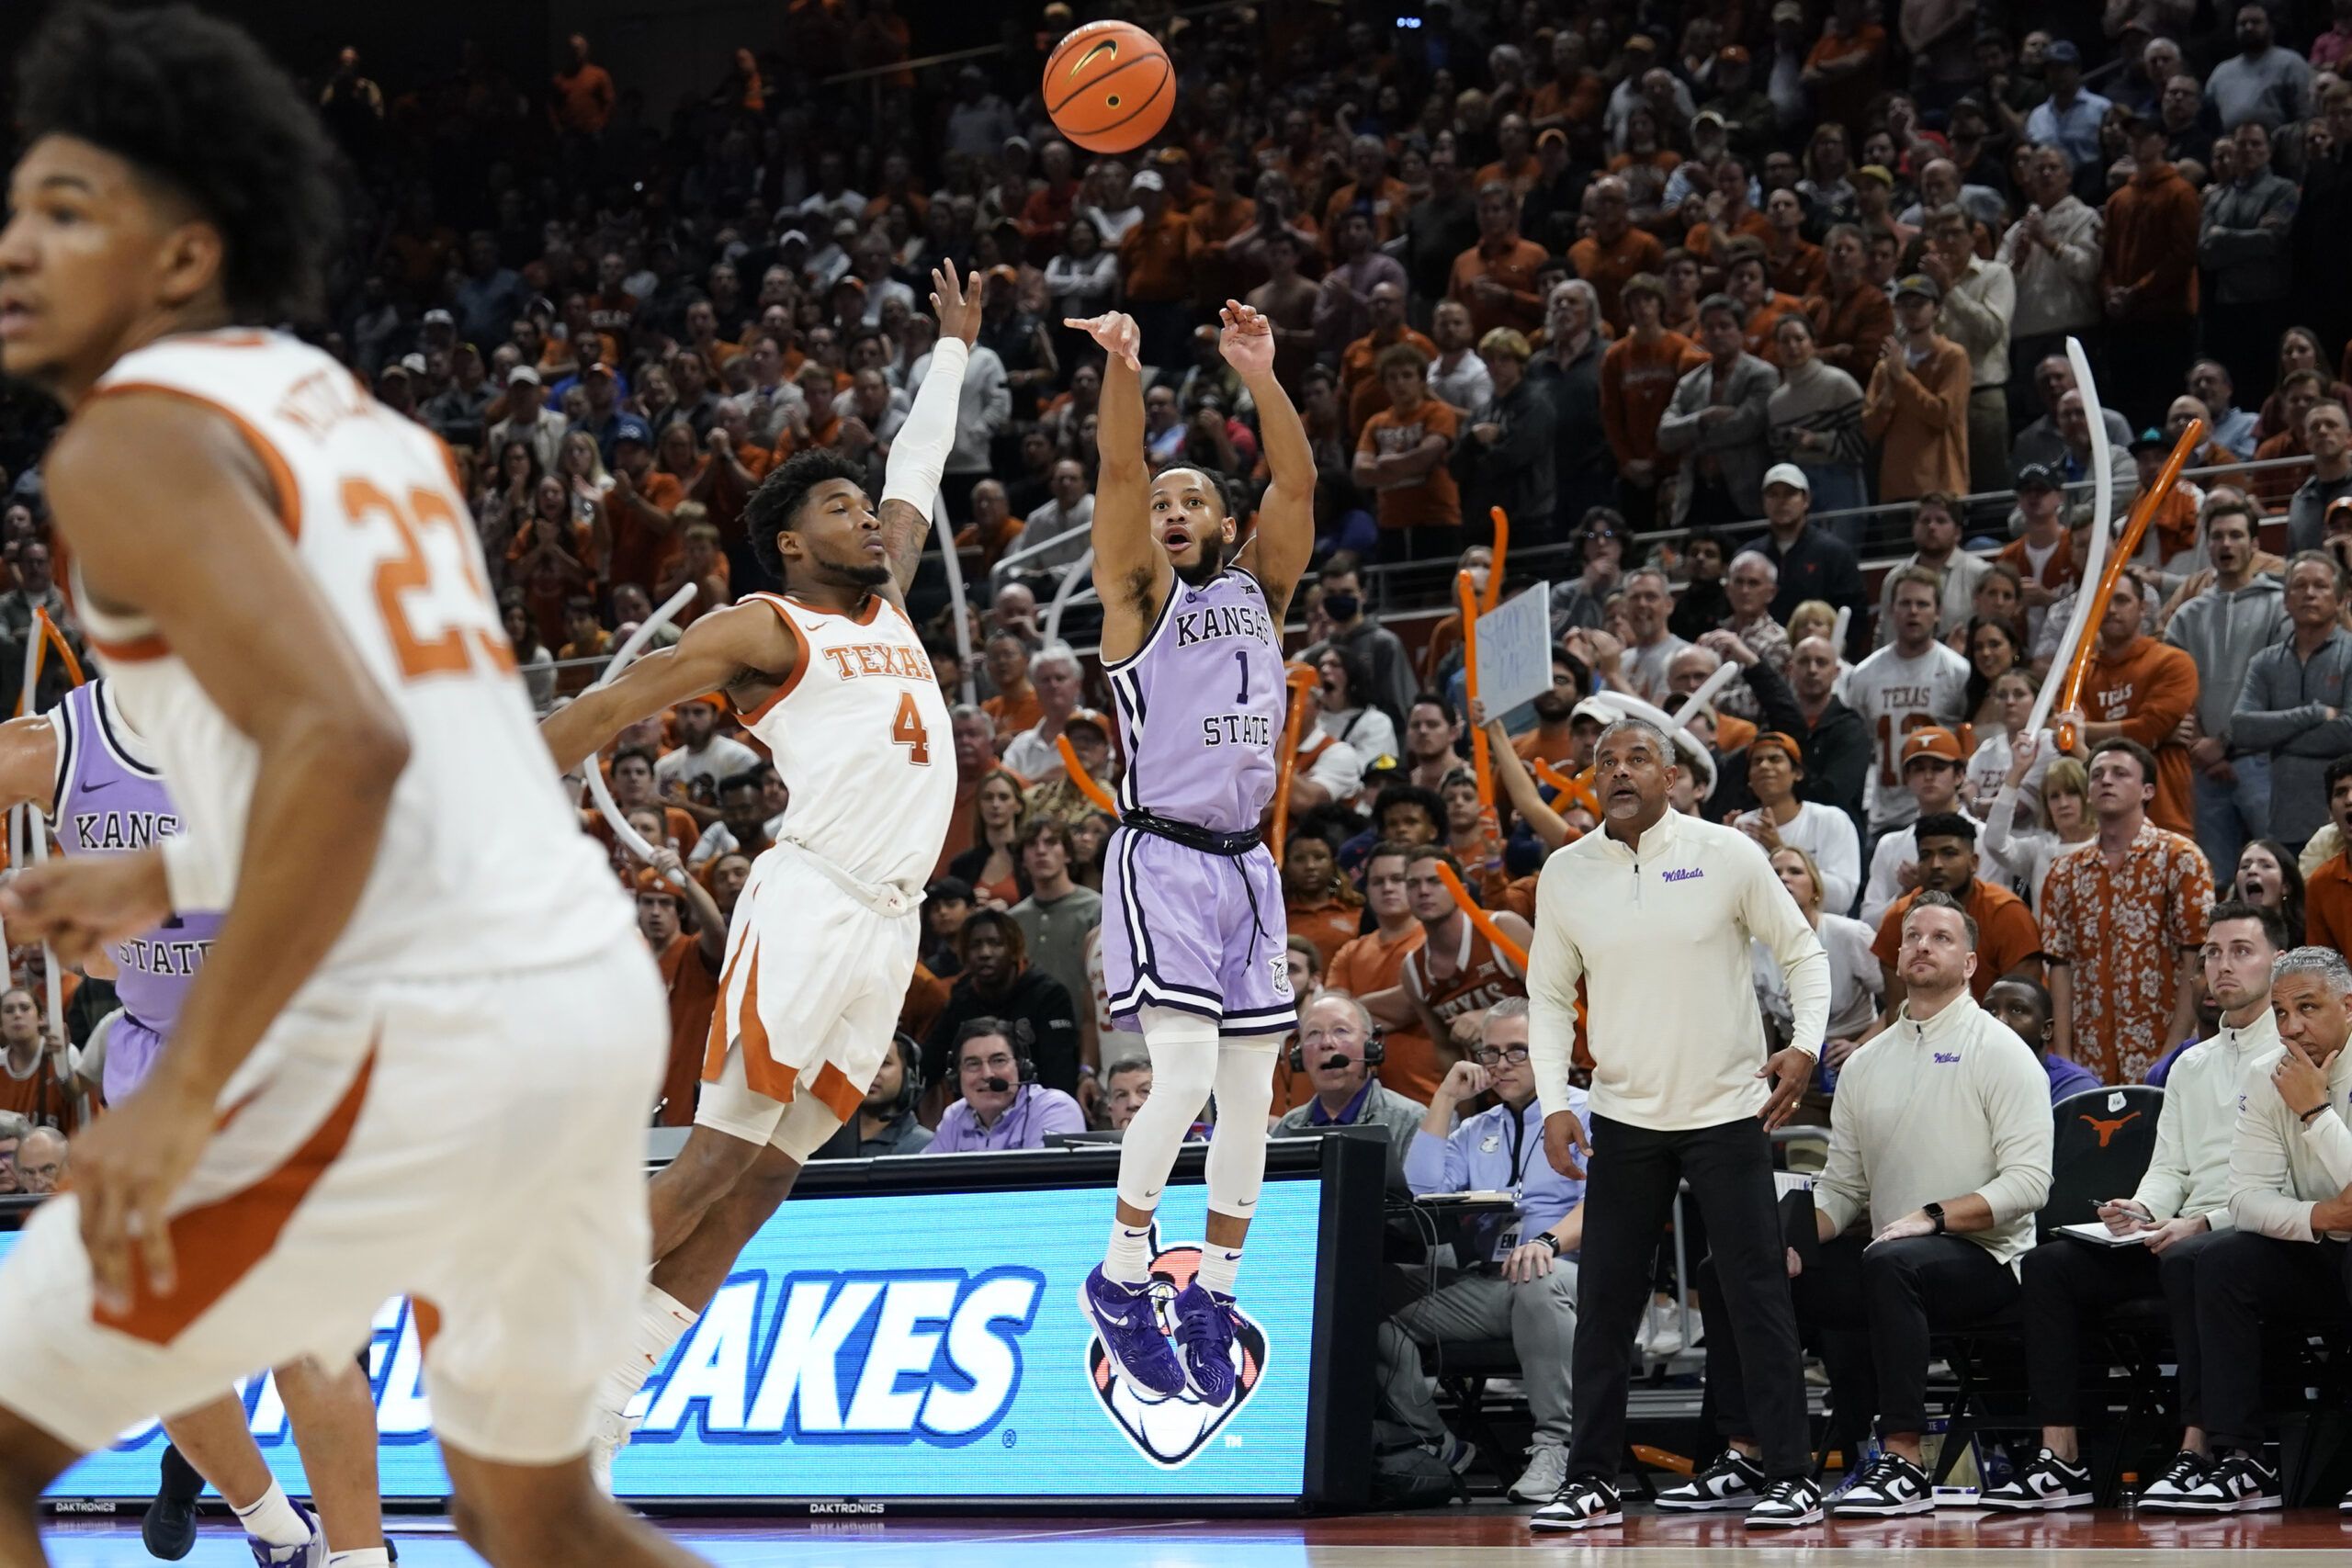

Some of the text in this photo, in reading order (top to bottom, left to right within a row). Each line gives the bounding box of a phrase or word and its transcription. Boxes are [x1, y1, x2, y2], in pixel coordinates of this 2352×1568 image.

[822, 643, 933, 682] TEXAS
[1235, 650, 1249, 705] 1
[1882, 685, 1930, 708] TEXAS
[890, 690, 931, 766] 4
[1204, 715, 1269, 747] STATE
[74, 811, 182, 850] KANS
[1662, 868, 1703, 882] Wildcats
[625, 1280, 1038, 1436] AKES
[56, 1502, 116, 1513] DAKTRONICS
[809, 1503, 885, 1514] DAKTRONICS
